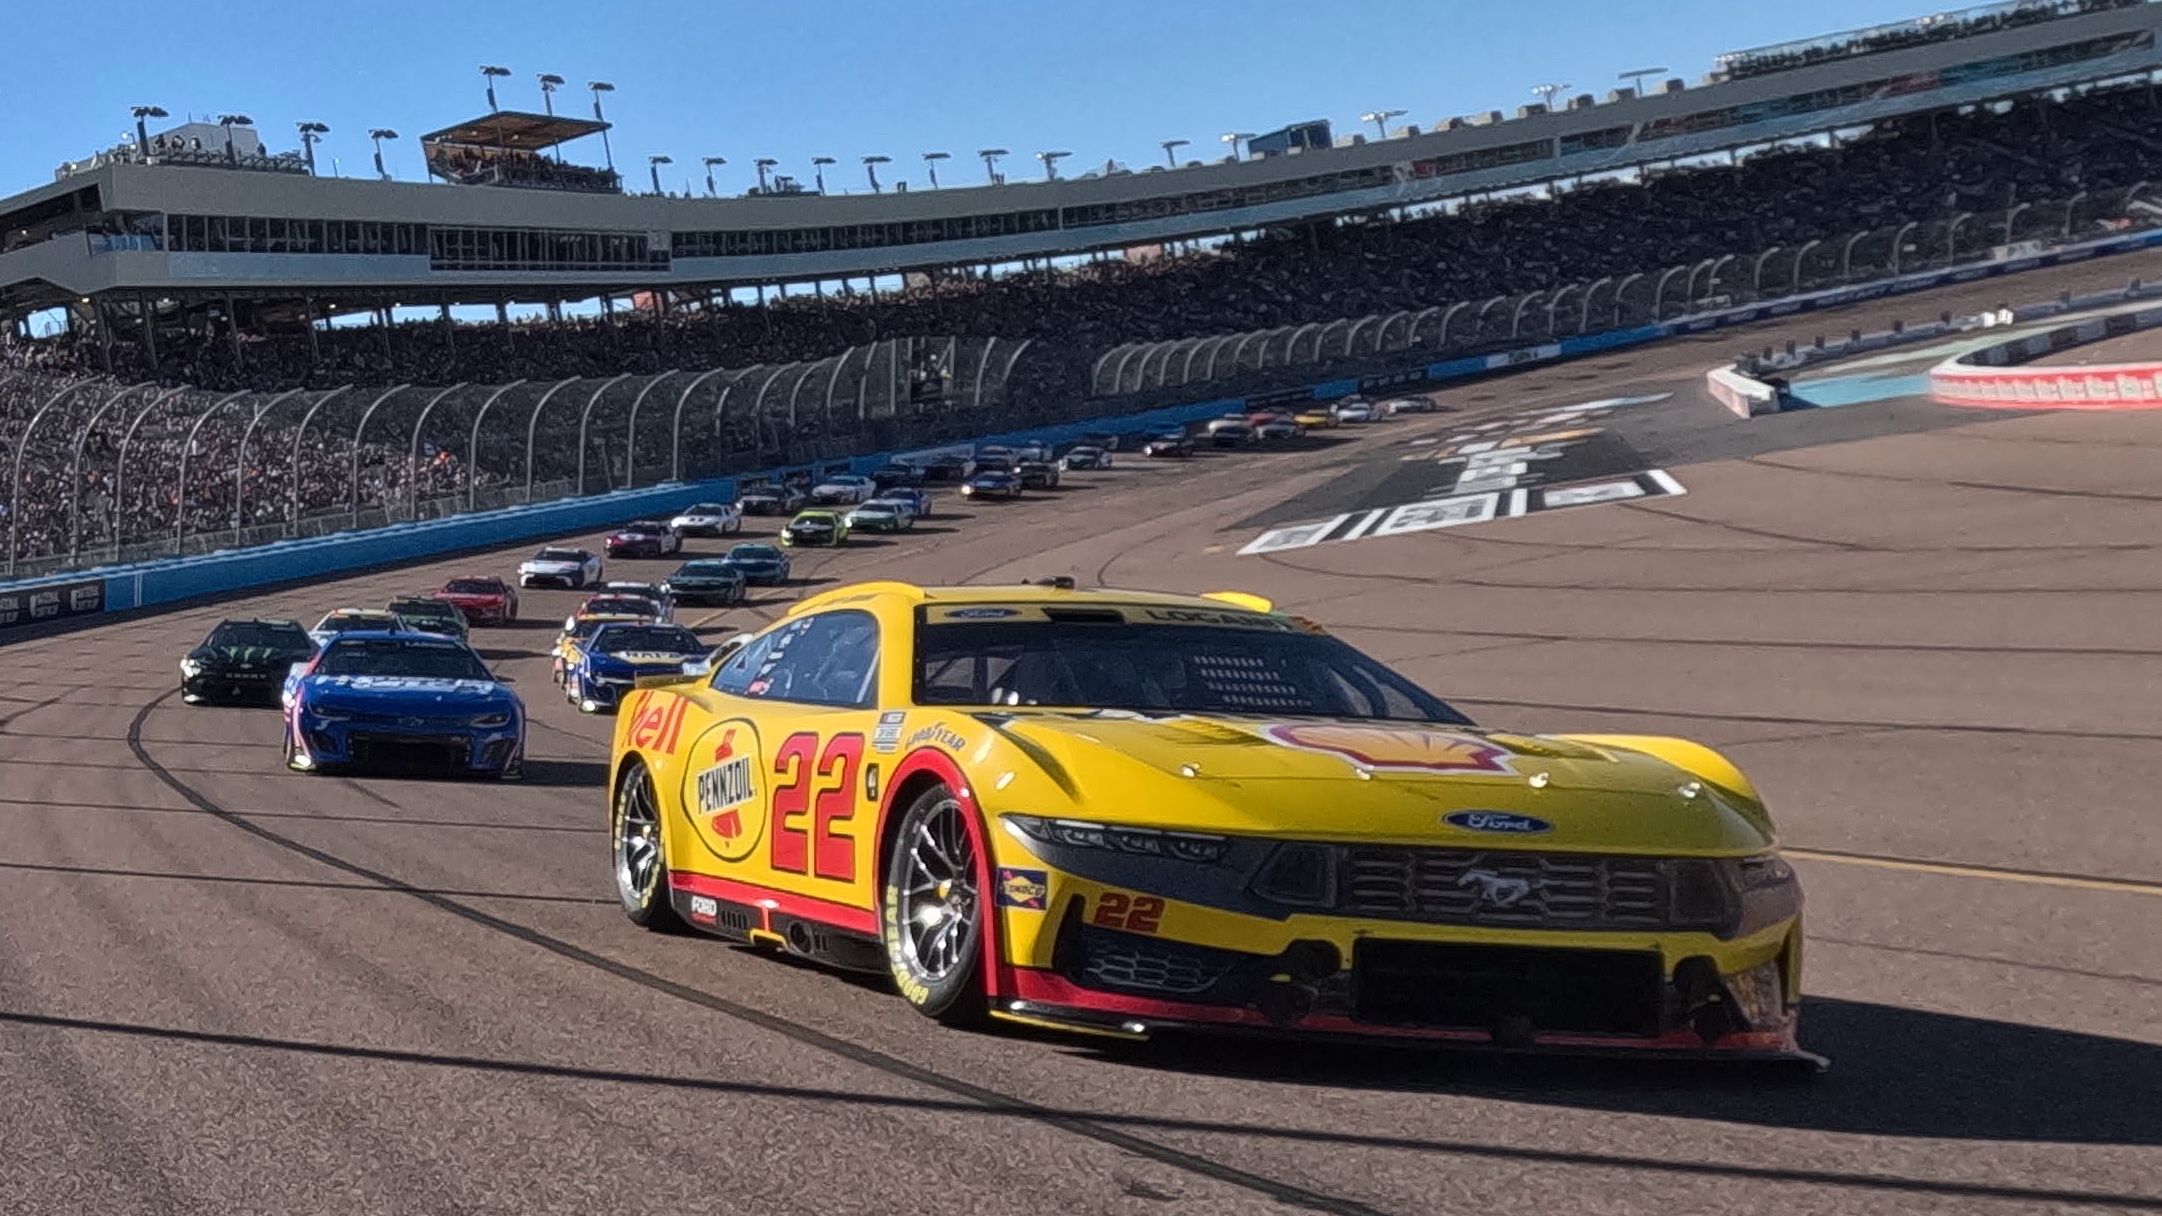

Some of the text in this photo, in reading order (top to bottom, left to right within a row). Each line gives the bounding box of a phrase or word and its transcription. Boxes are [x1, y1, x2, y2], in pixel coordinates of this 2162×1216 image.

[697, 756, 754, 816] PENNZOIL
[771, 731, 866, 885] 22
[1467, 813, 1534, 831] Ford
[691, 895, 717, 917] FORD
[1094, 892, 1166, 934] 22
